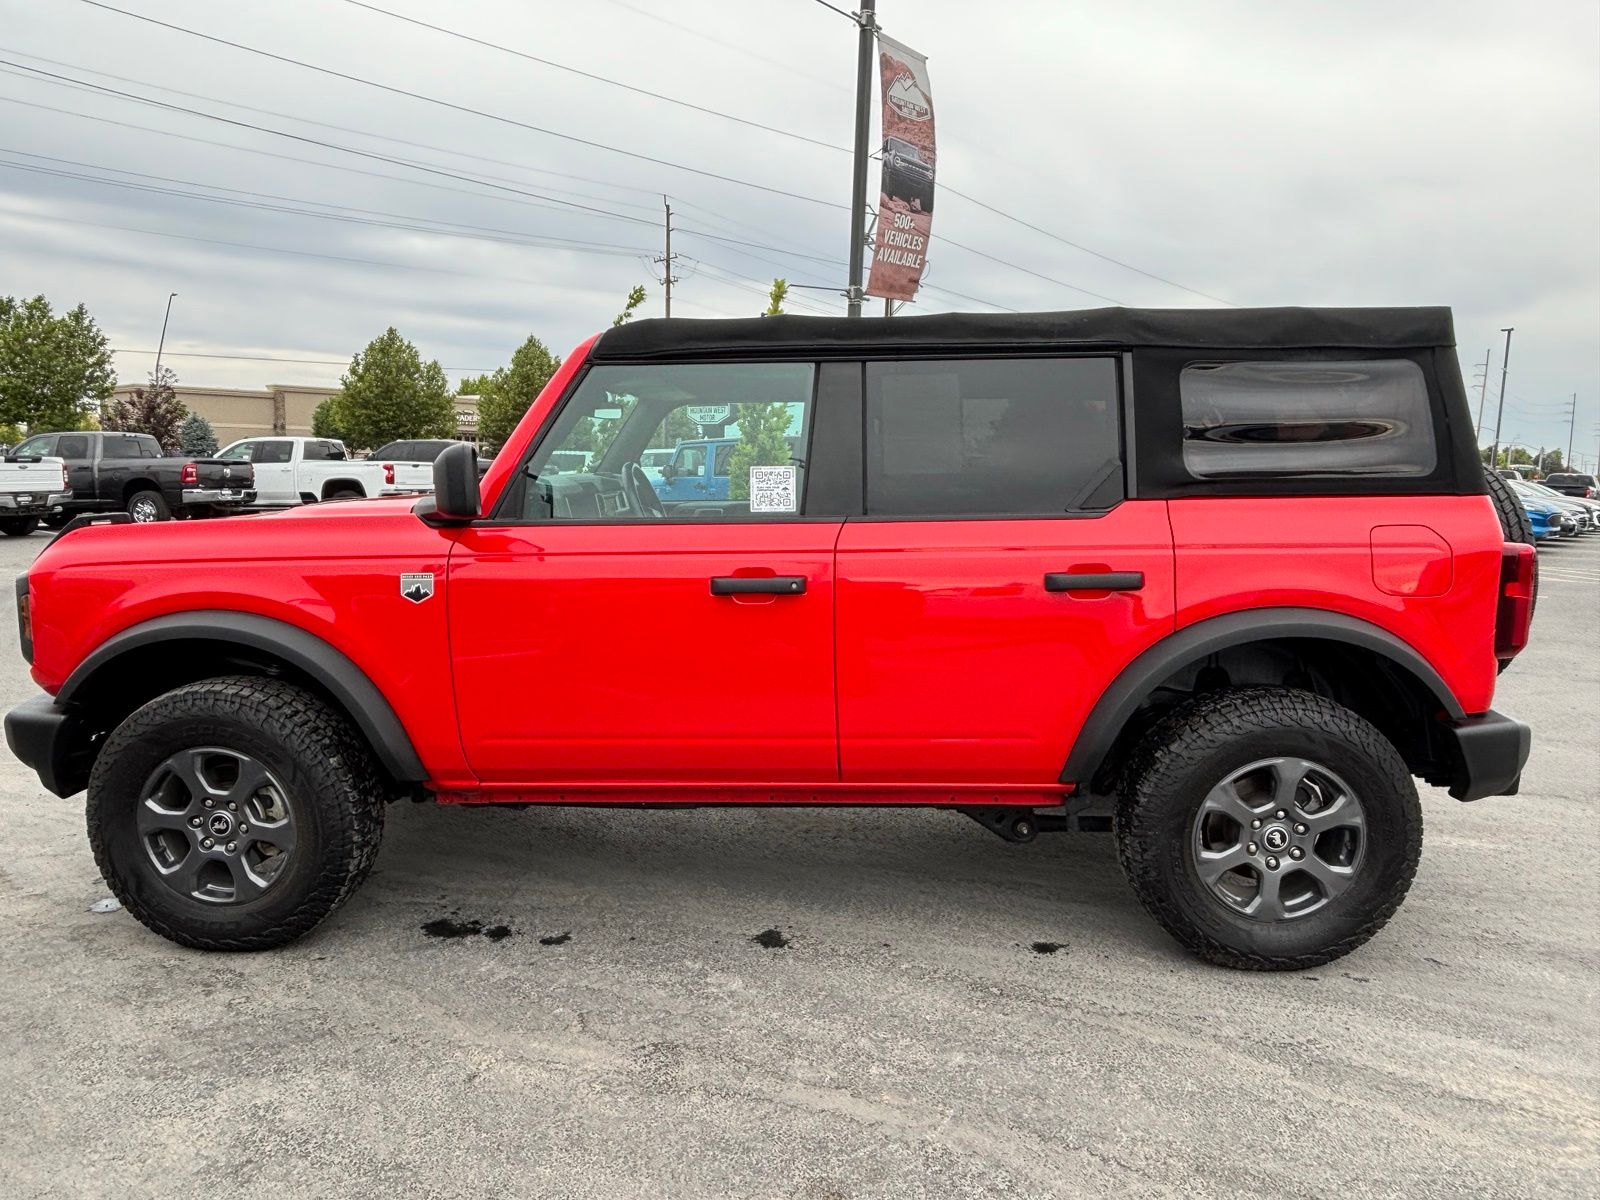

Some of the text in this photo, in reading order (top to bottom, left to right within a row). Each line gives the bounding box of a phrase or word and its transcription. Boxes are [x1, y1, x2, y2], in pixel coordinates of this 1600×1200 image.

[894, 212, 915, 229] 500+
[884, 229, 923, 250] VEHICLES
[876, 247, 922, 268] AVAILABLE
[713, 406, 726, 414] WEST
